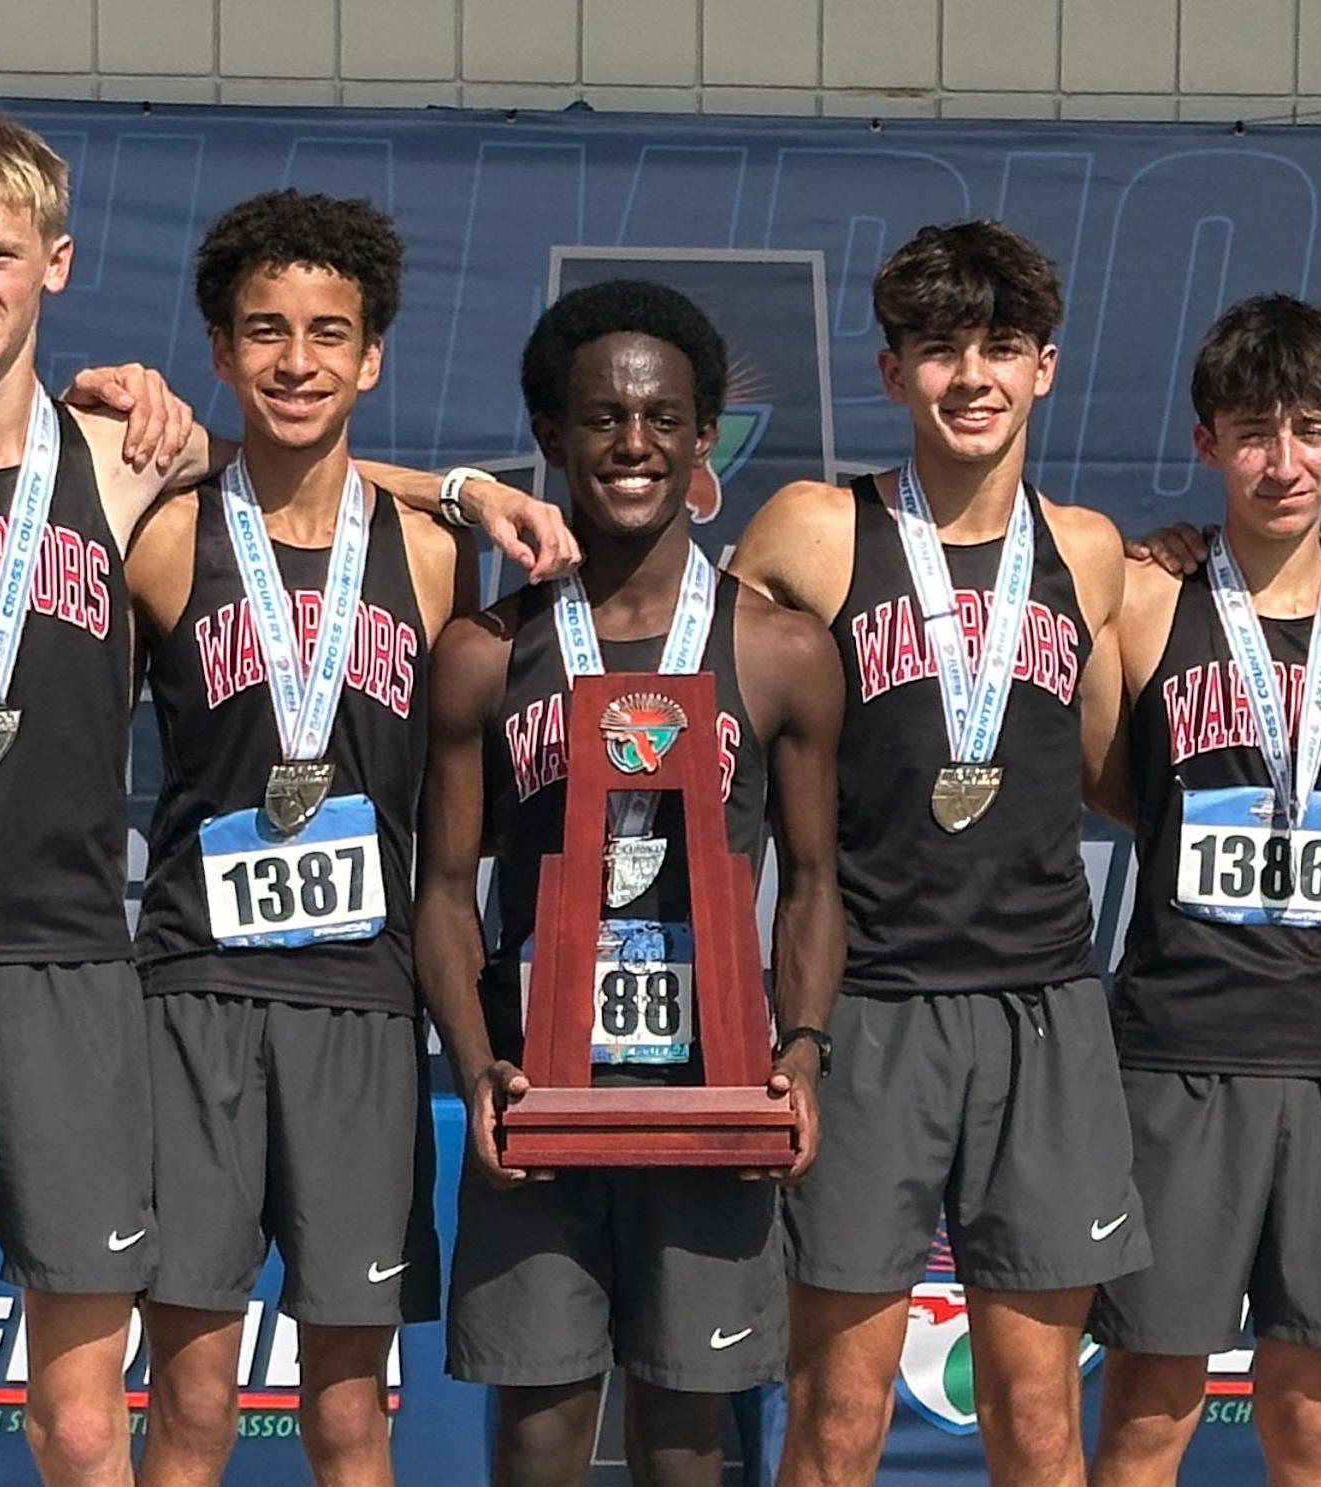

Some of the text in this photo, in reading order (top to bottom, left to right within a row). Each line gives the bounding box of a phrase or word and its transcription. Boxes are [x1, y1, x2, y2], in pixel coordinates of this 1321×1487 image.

[2, 472, 43, 619] CROSS COUNTRY
[236, 510, 283, 643] CROSS COUNTRY
[322, 541, 357, 681] CROSS COUNTRY
[675, 614, 699, 673] UNTRY
[194, 589, 418, 720] WARORS
[970, 681, 998, 762] COUNTRY
[221, 846, 365, 927] 1387
[601, 970, 681, 1036] 88
[1205, 1400, 1254, 1424] SCH
